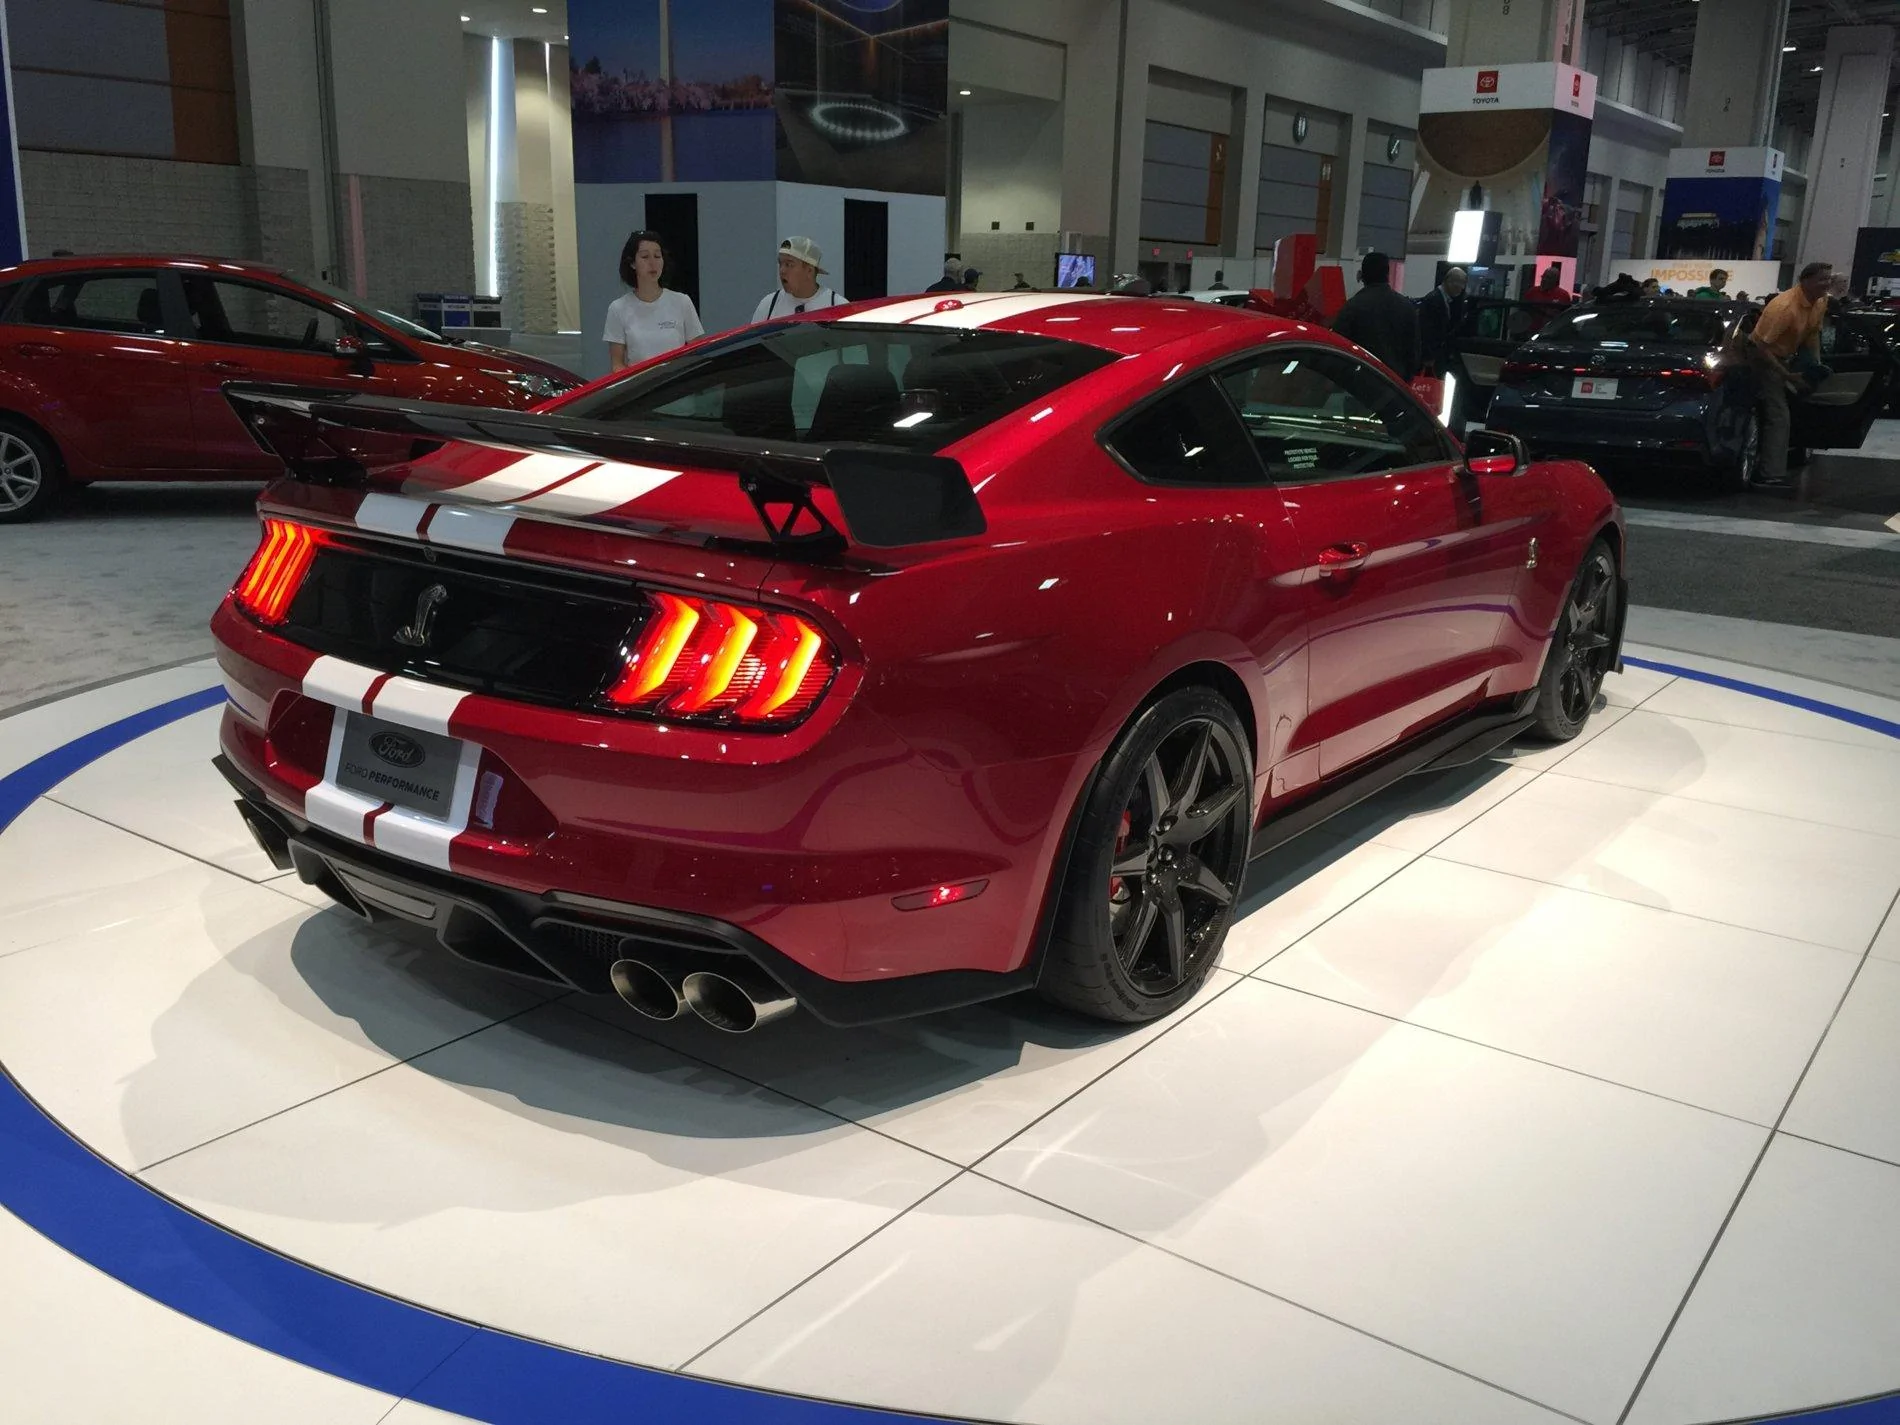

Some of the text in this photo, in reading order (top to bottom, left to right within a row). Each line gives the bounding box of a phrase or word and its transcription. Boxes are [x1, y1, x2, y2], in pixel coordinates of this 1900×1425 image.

[1652, 269, 1734, 281] IMPOSSIE
[380, 736, 415, 761] Ford
[344, 763, 440, 801] FORD PERFORMANCE
